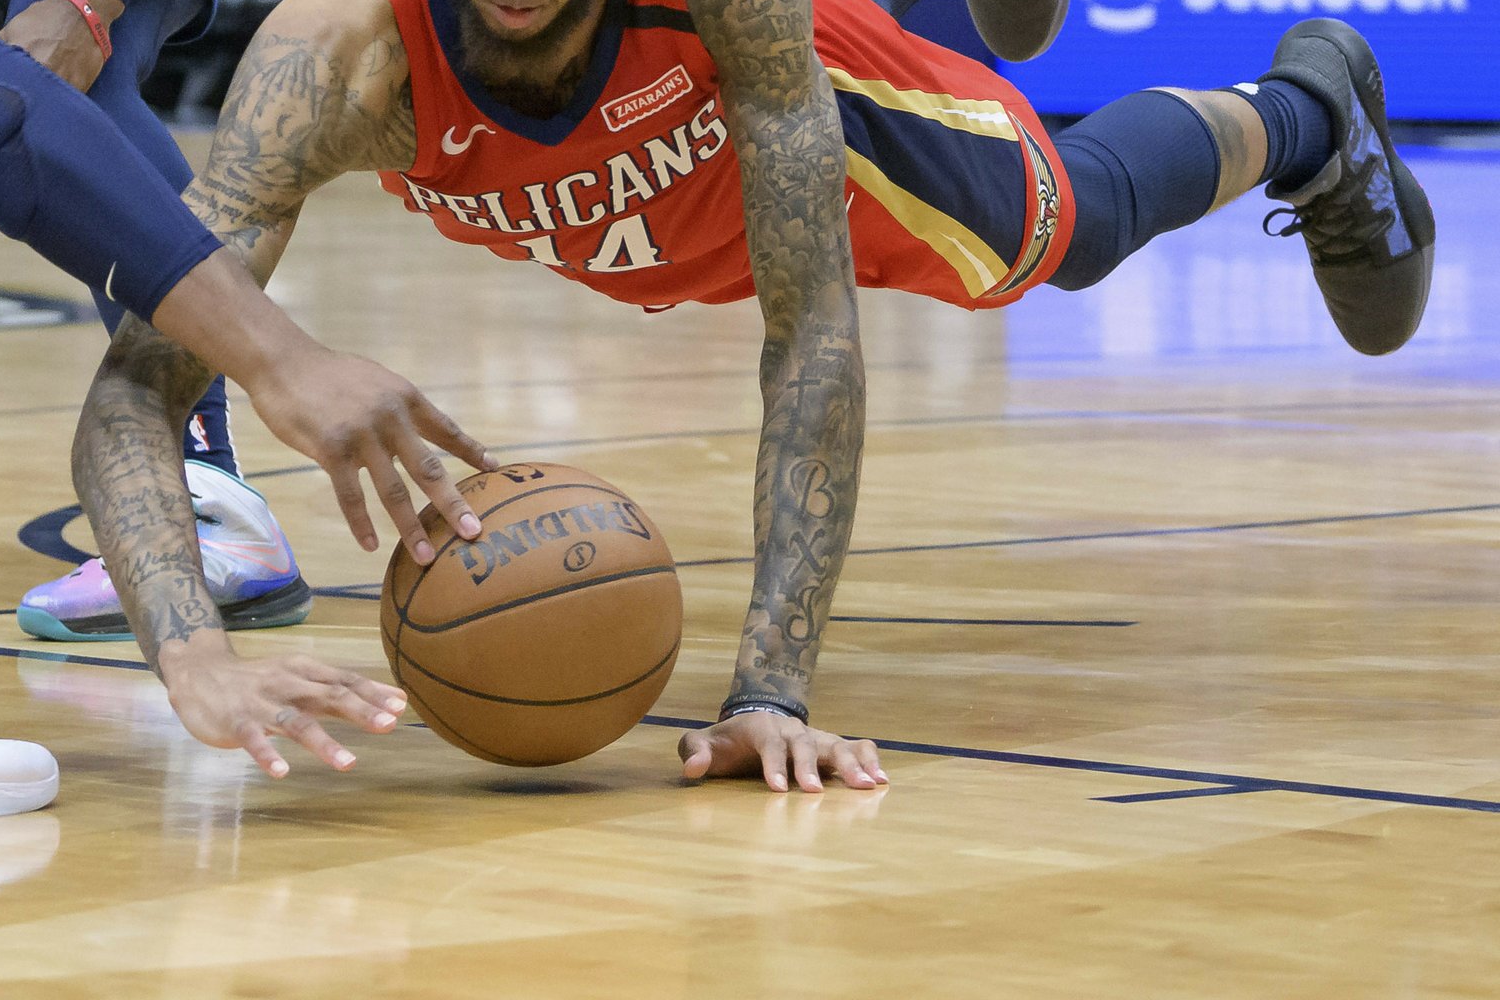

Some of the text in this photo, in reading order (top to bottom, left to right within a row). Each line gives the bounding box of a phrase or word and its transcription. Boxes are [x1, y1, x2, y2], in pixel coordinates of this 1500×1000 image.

[614, 74, 684, 119] ZATARAIN'S
[403, 99, 729, 234] PELICANS
[515, 213, 672, 273] 14
[451, 501, 651, 586] SPALDING
